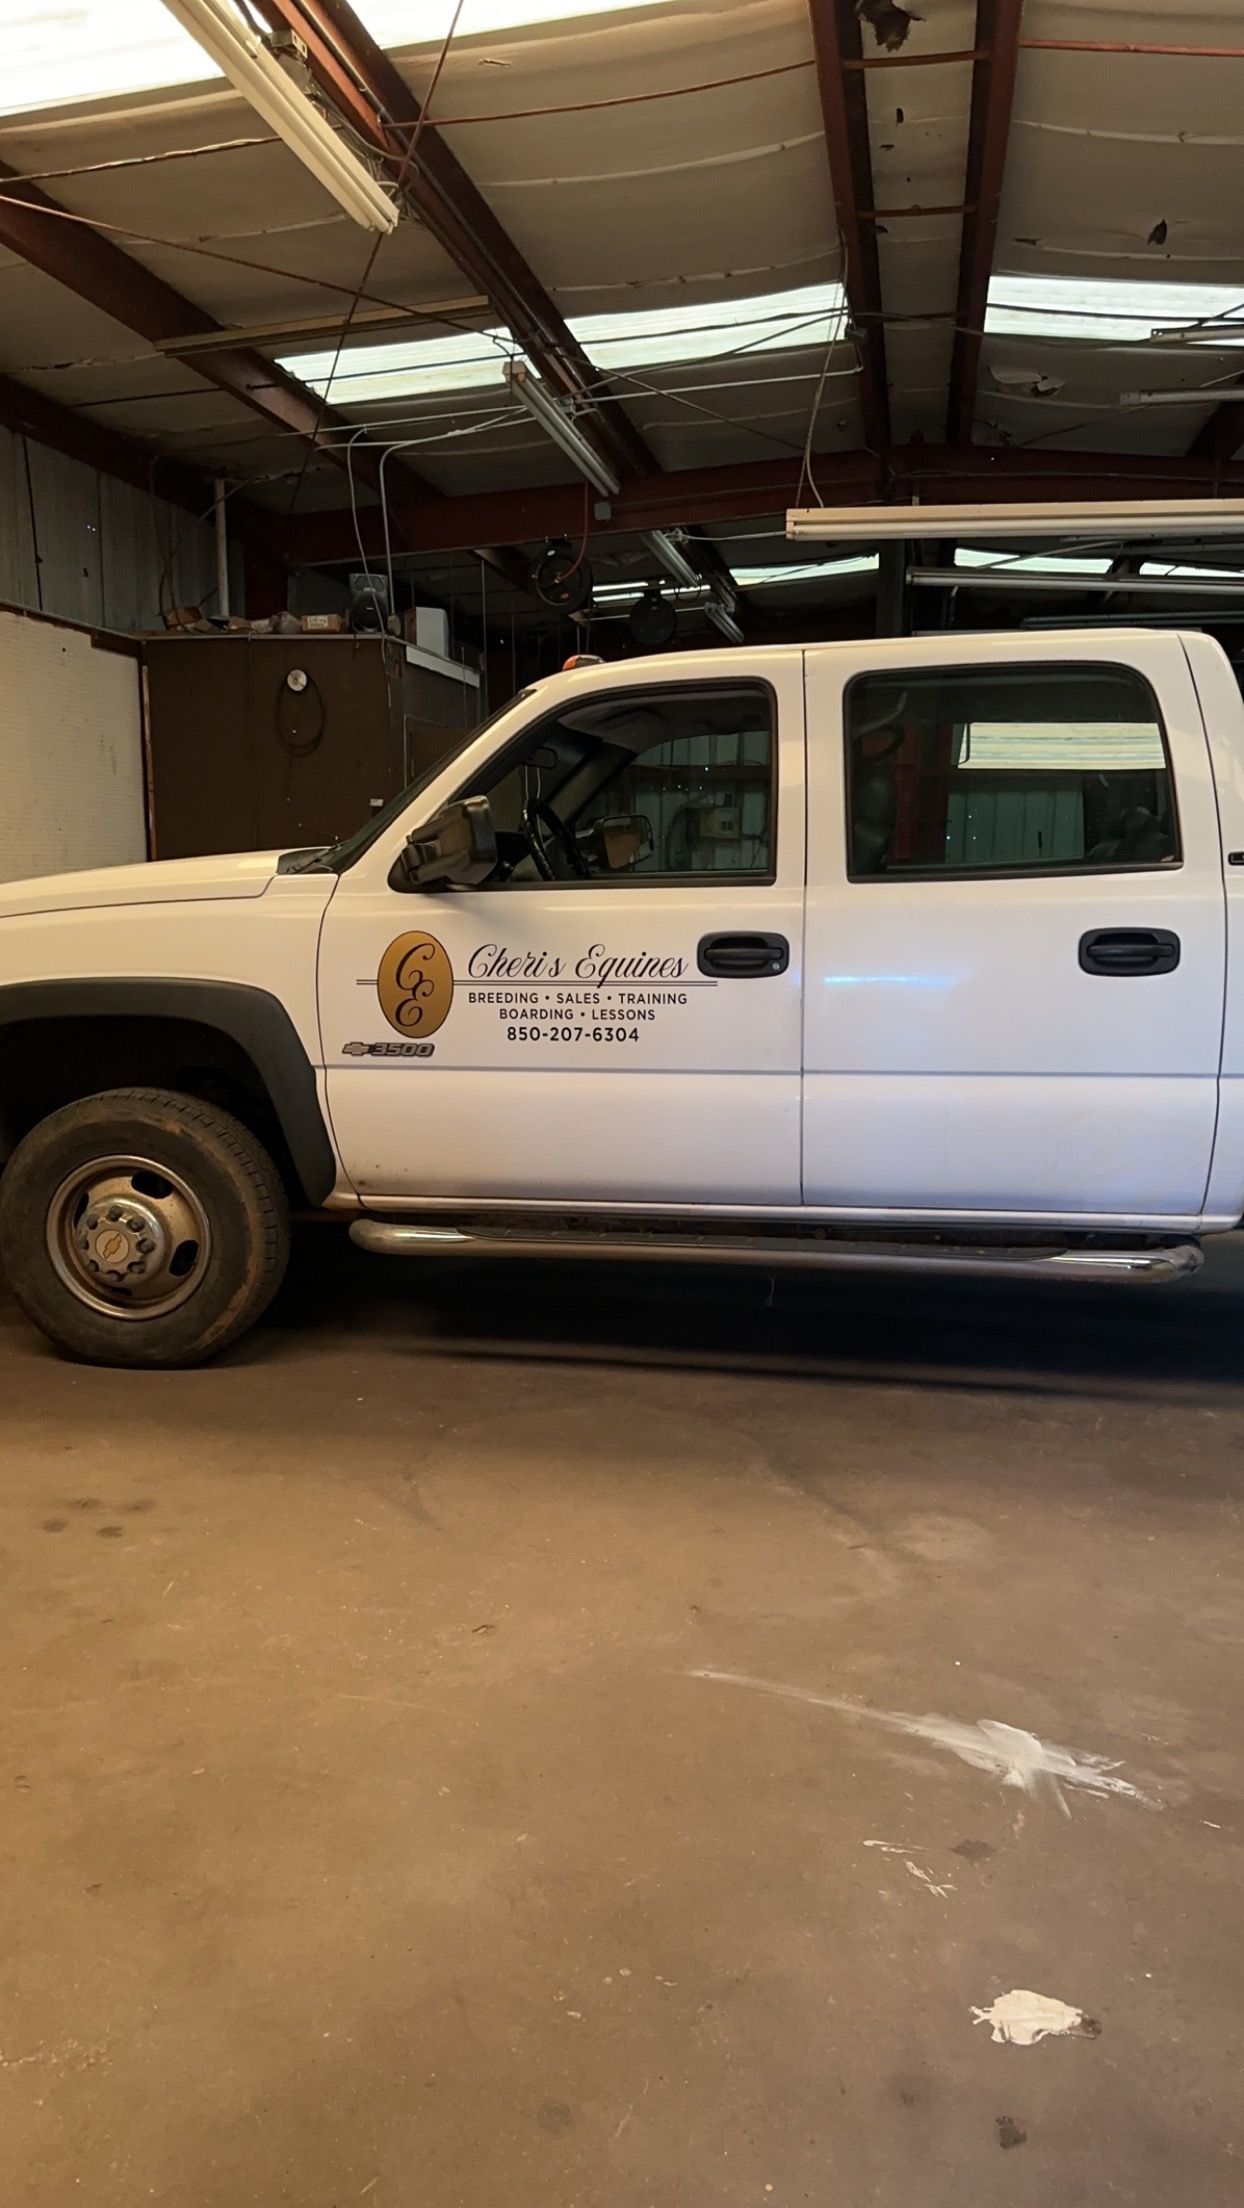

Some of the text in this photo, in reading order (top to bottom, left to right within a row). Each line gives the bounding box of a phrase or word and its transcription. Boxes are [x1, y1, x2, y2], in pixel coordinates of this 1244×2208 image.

[575, 943, 690, 989] Equines
[468, 992, 688, 1005] BREEDING SALES TRAINING
[499, 1008, 656, 1021] BOARDING LESSONS
[507, 1026, 640, 1042] 850-207-6304
[370, 1042, 436, 1058] 3500
